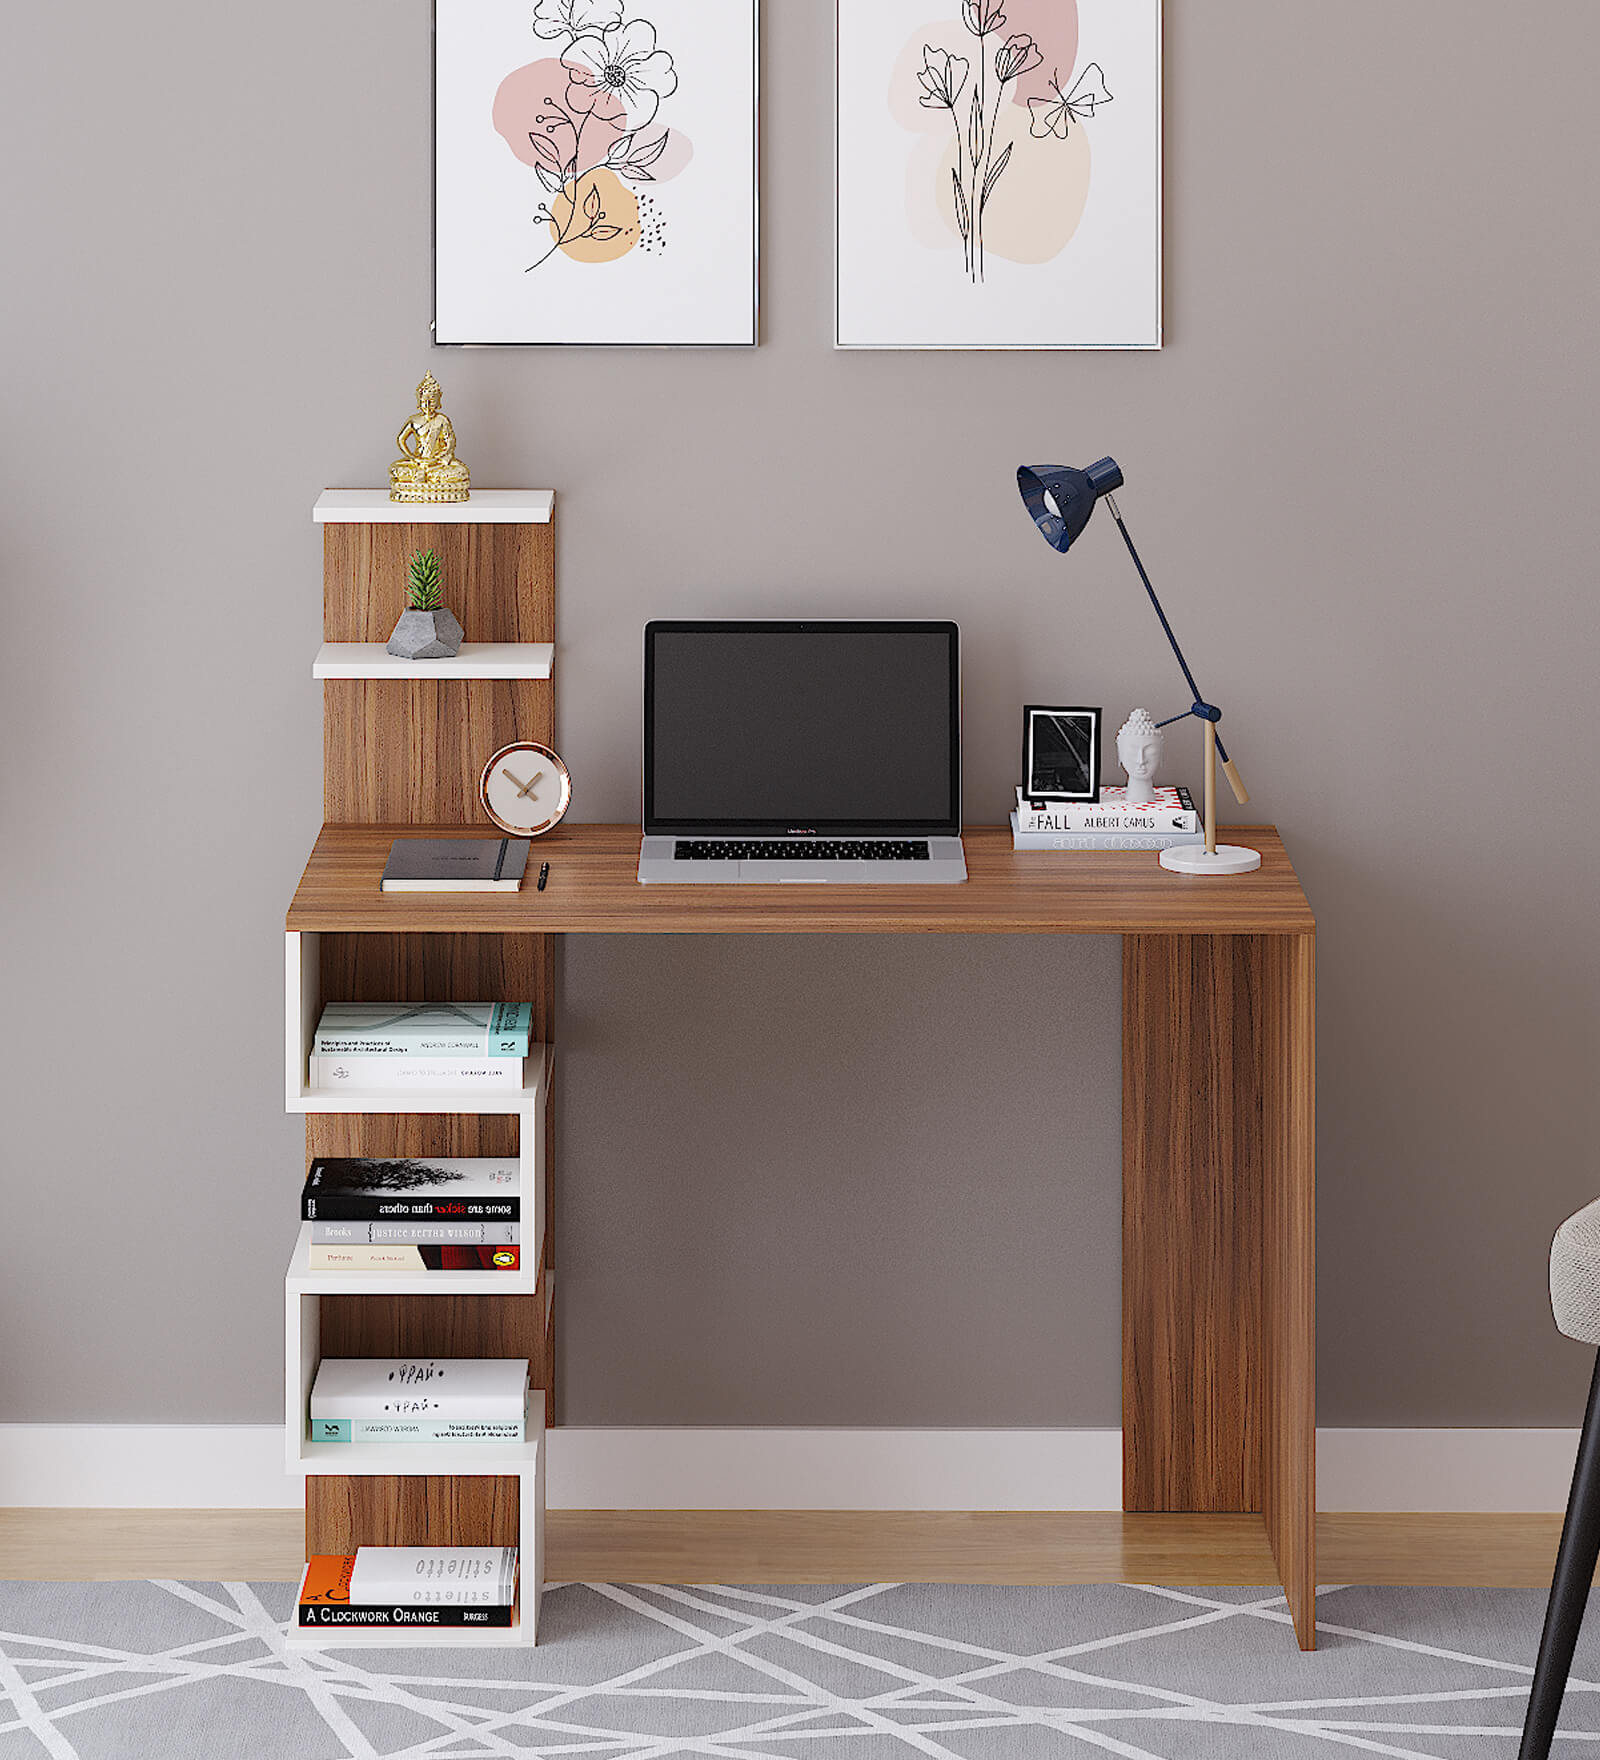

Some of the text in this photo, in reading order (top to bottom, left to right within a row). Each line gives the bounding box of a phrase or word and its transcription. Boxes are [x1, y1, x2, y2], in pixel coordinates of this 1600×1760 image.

[1037, 815, 1071, 830] FALL
[1084, 817, 1120, 829] ALBERT
[1123, 817, 1155, 829] CAMUS
[306, 1608, 439, 1623] A CLOCKWORK ORANGE
